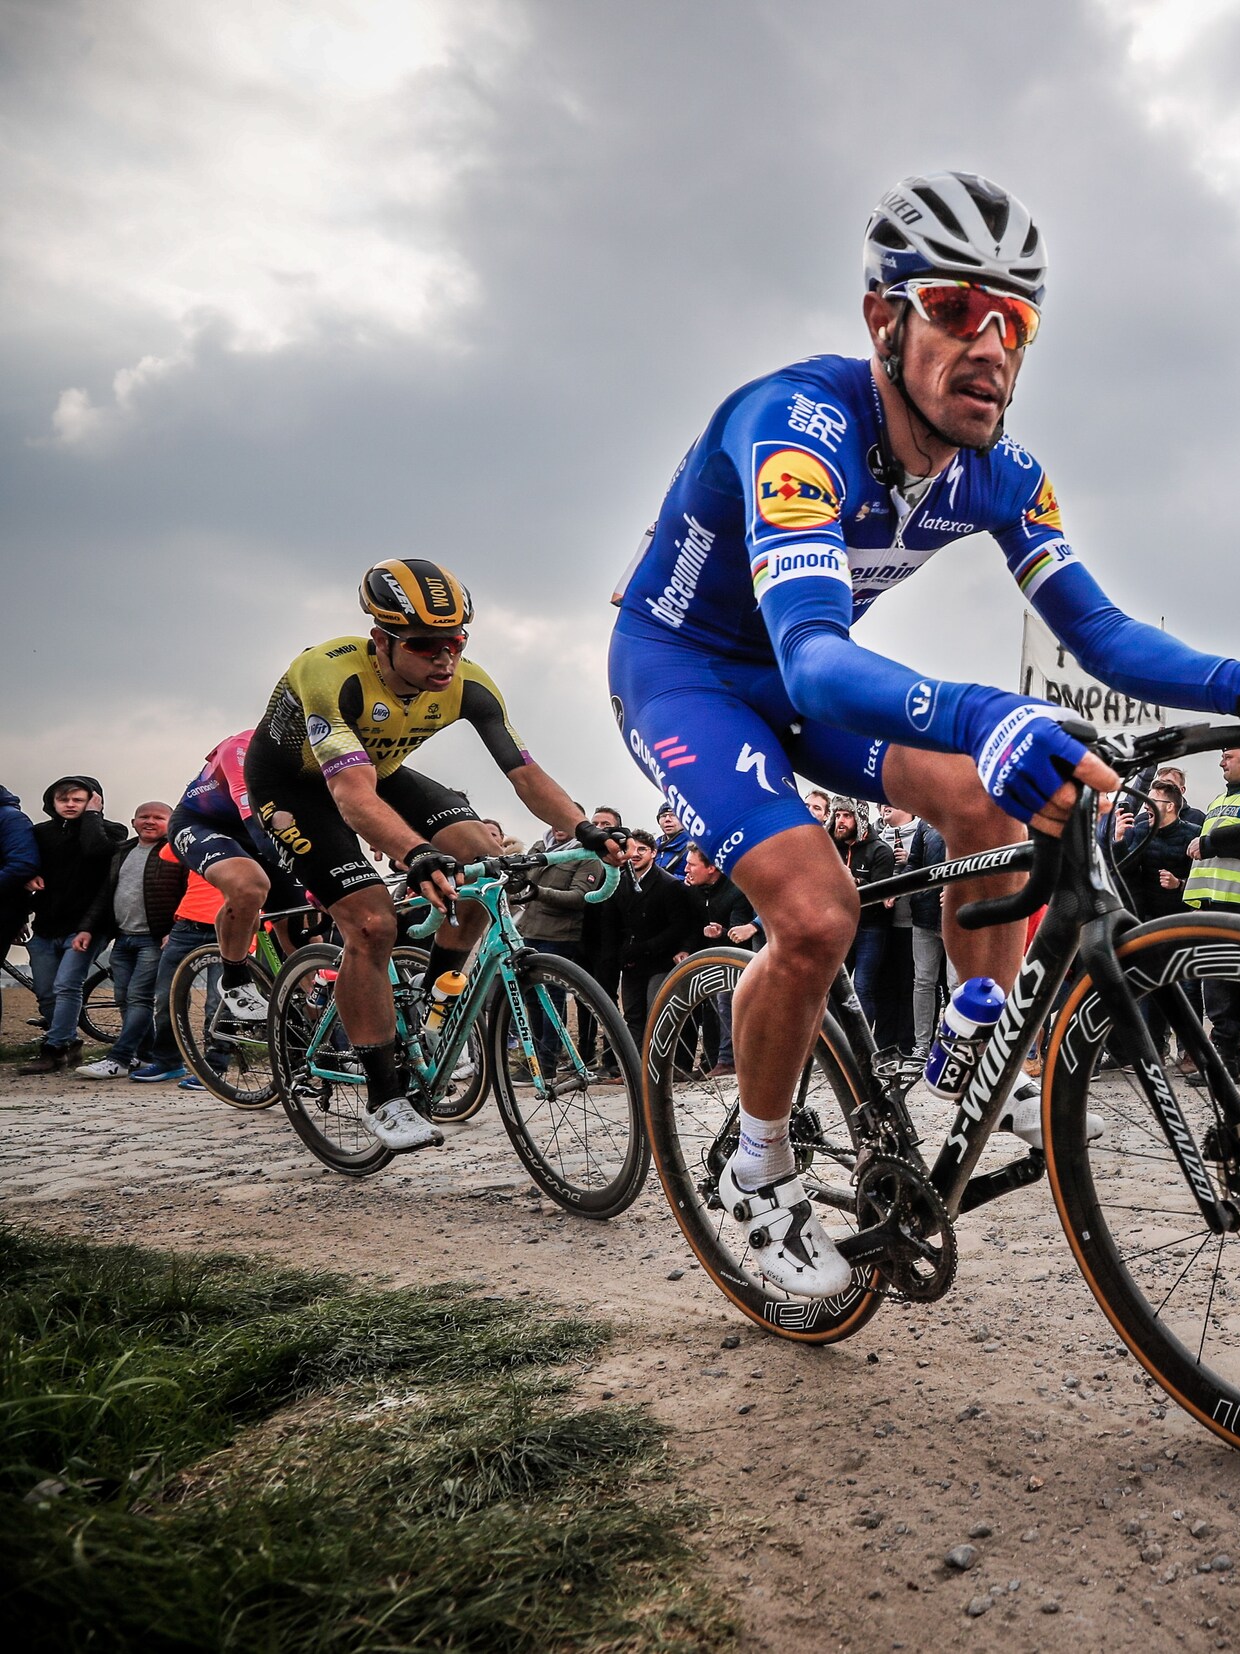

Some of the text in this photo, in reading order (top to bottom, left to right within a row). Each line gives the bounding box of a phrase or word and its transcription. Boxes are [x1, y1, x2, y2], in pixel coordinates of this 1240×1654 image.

[805, 402, 848, 453] PRO
[917, 510, 975, 534] latexco
[424, 577, 450, 608] WOUT
[645, 512, 716, 628] deceuninck
[381, 573, 415, 614] LAZER
[324, 643, 358, 659] JUMBO
[1010, 732, 1034, 764] STEP
[260, 801, 313, 855] JUBO
[666, 784, 705, 838] STEP
[927, 848, 1017, 882] SPECIALIZED
[190, 953, 223, 972] Visio
[508, 980, 529, 1042] Bianchi
[946, 957, 1046, 1165] S-WORKS
[1140, 1057, 1216, 1204] SPECIALIZED
